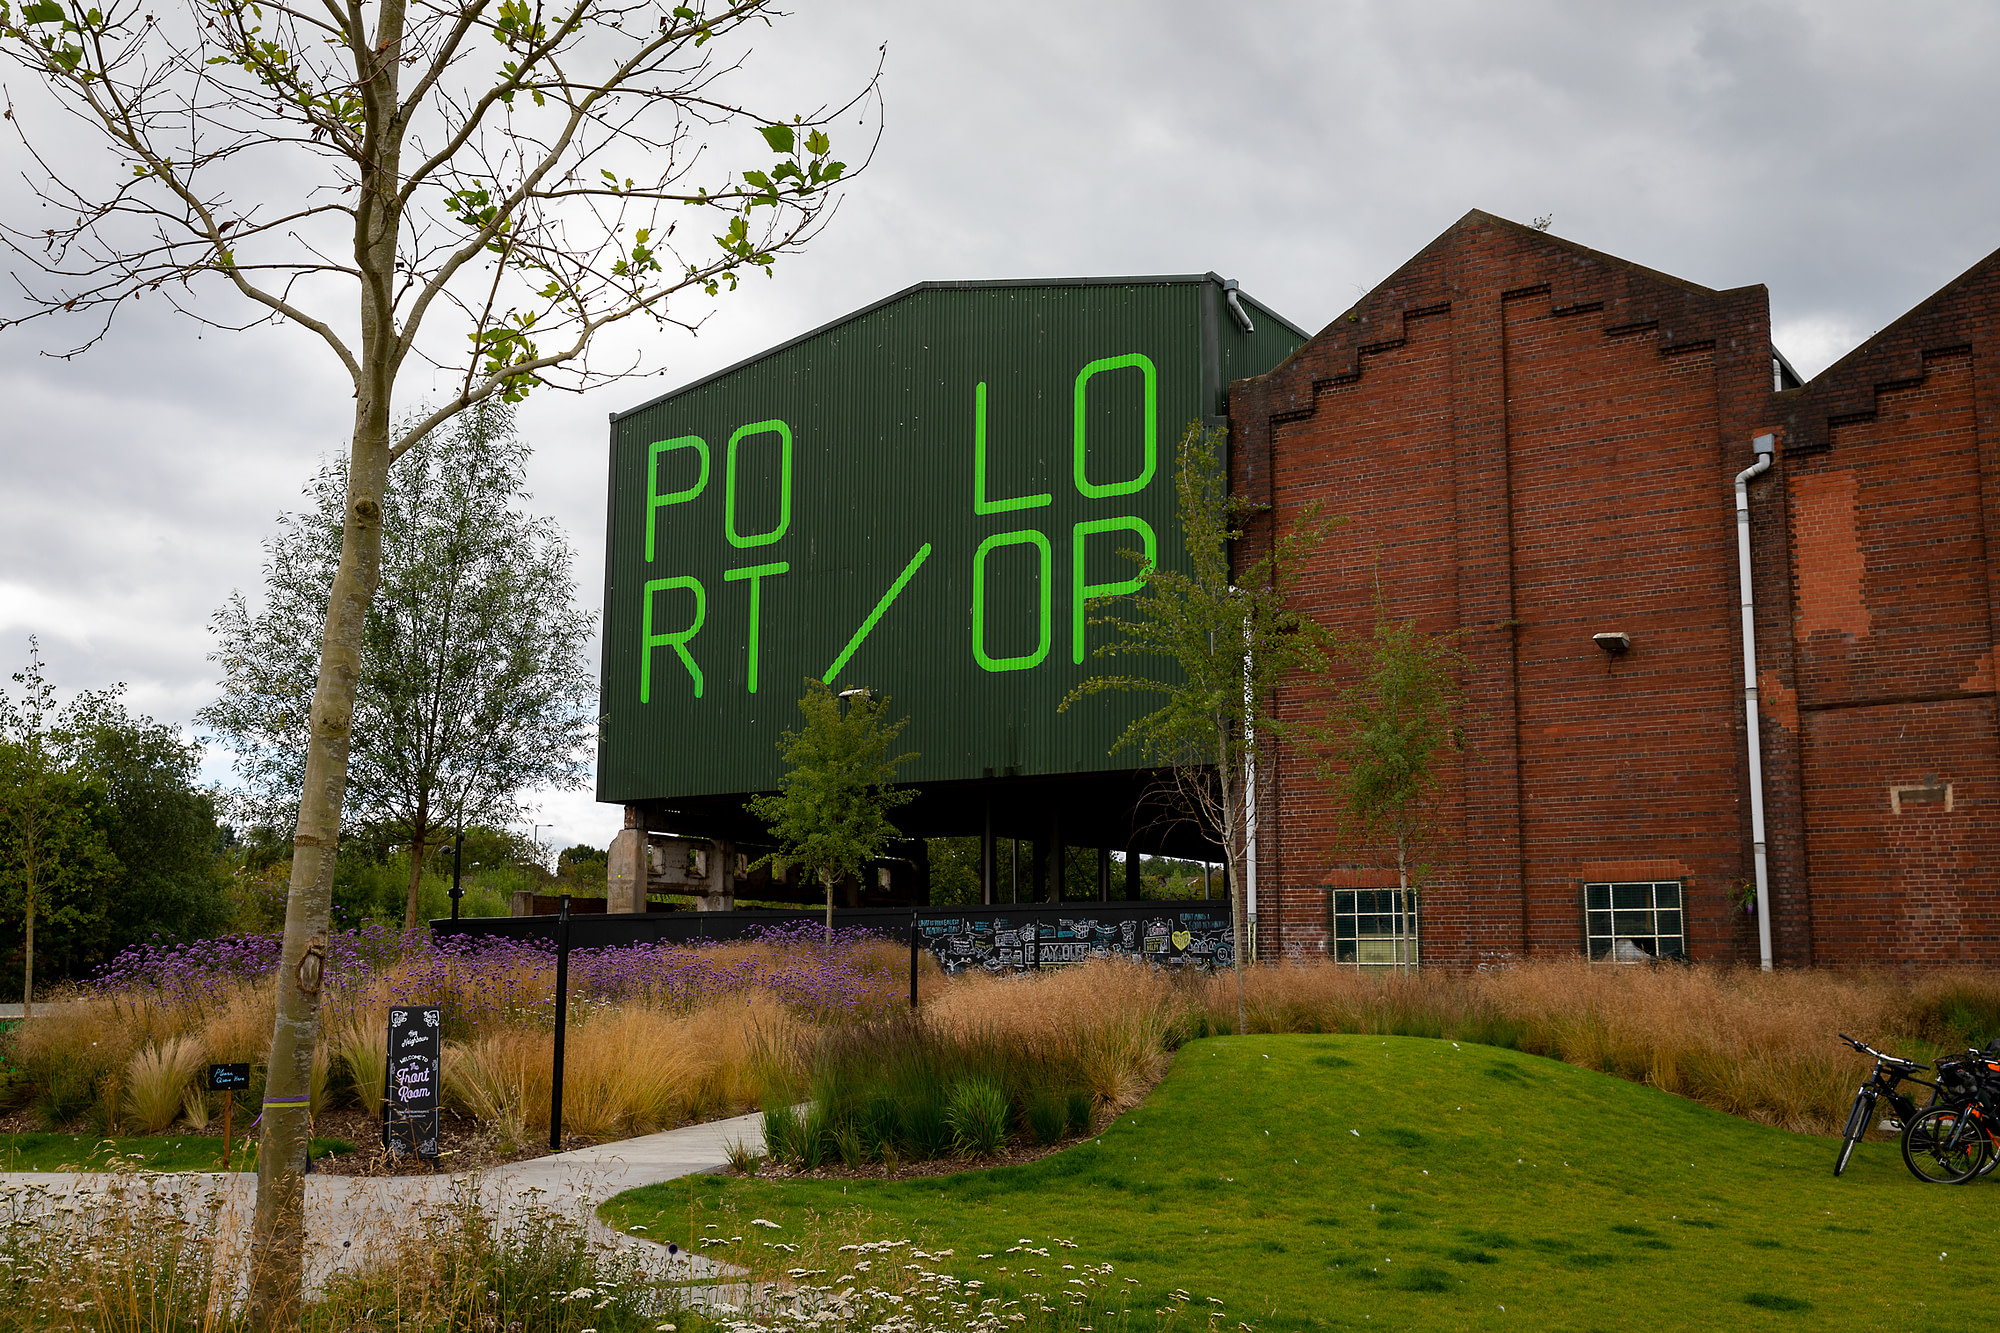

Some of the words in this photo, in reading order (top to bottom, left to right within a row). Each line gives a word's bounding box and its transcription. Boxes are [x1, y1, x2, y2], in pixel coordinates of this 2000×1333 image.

[645, 419, 792, 562] PO
[974, 353, 1157, 515] LO
[640, 561, 790, 704] RT
[973, 516, 1157, 672] OP
[396, 1067, 430, 1086] Front
[398, 1085, 431, 1103] Room
